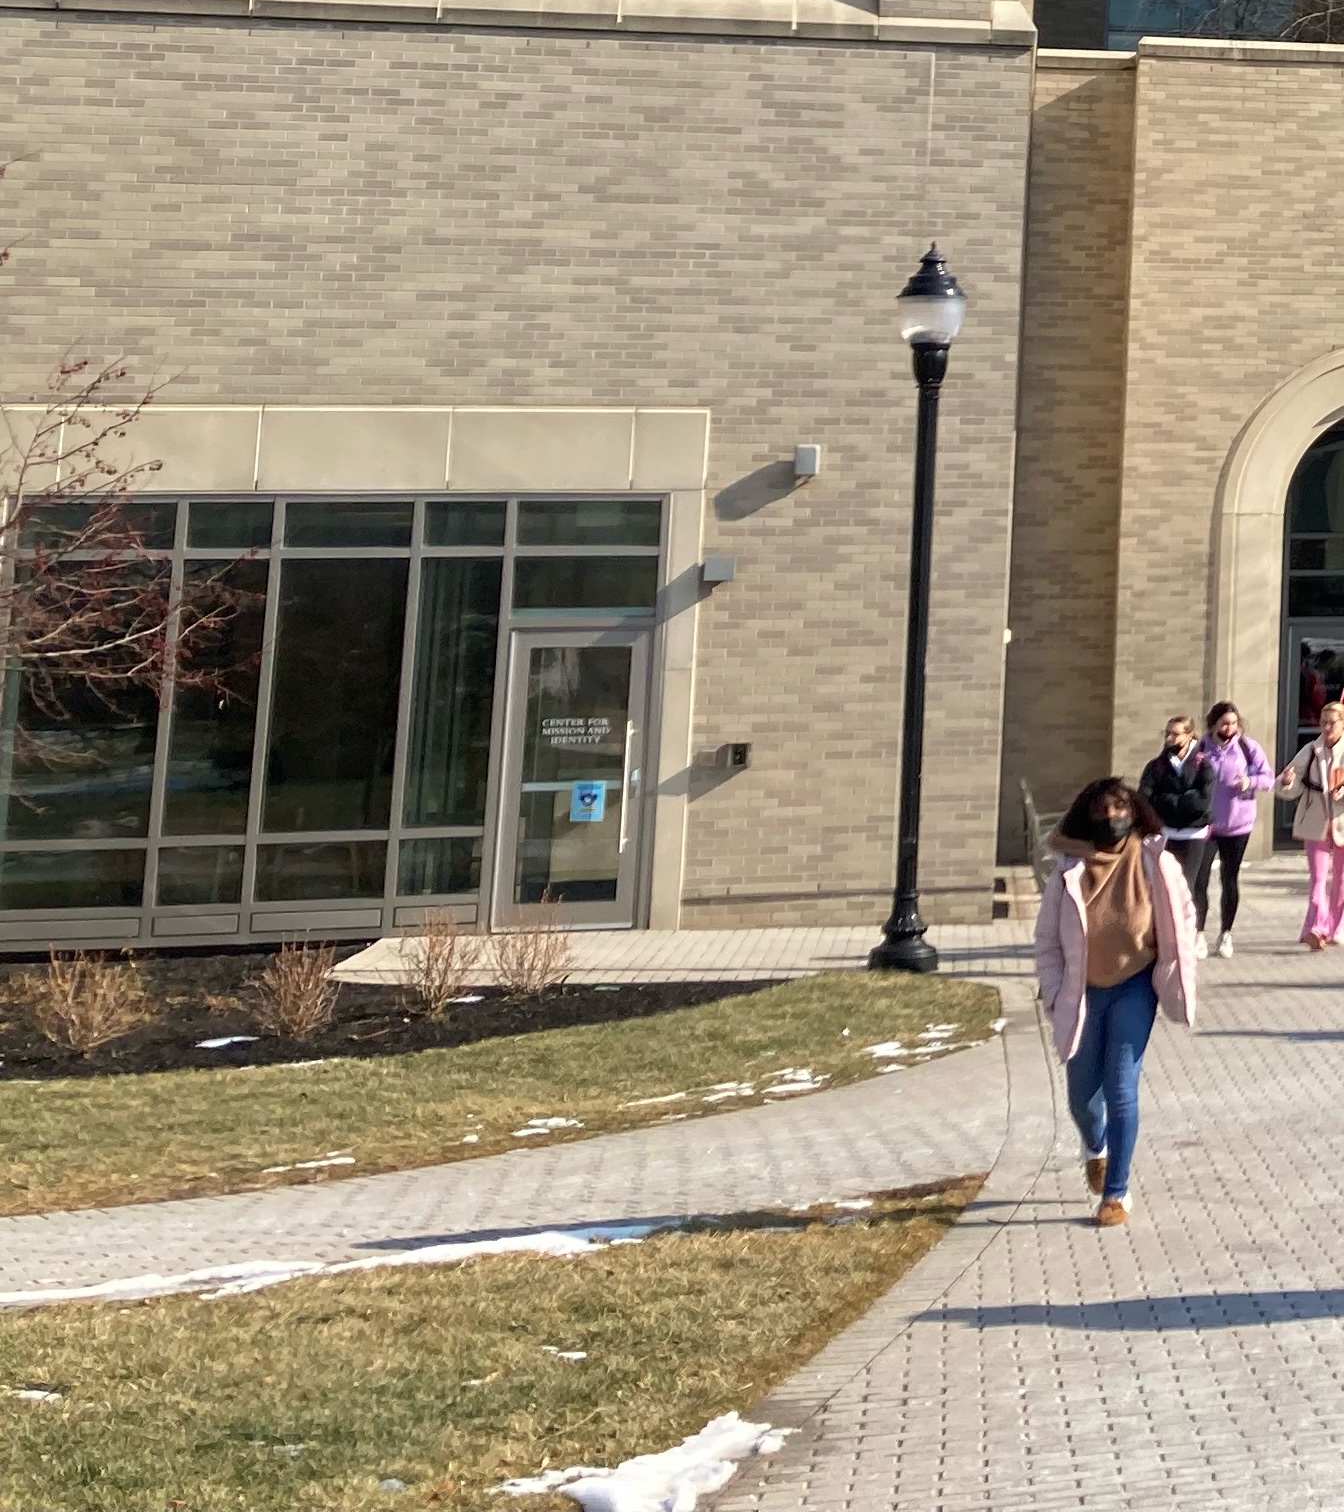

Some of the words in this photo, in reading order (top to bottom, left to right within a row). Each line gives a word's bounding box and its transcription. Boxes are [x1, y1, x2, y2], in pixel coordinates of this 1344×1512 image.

[541, 718, 584, 726] CENTER
[587, 718, 609, 726] FOR
[541, 727, 585, 736] MISSION
[587, 727, 611, 735] AND
[550, 736, 601, 745] IDENTITY
